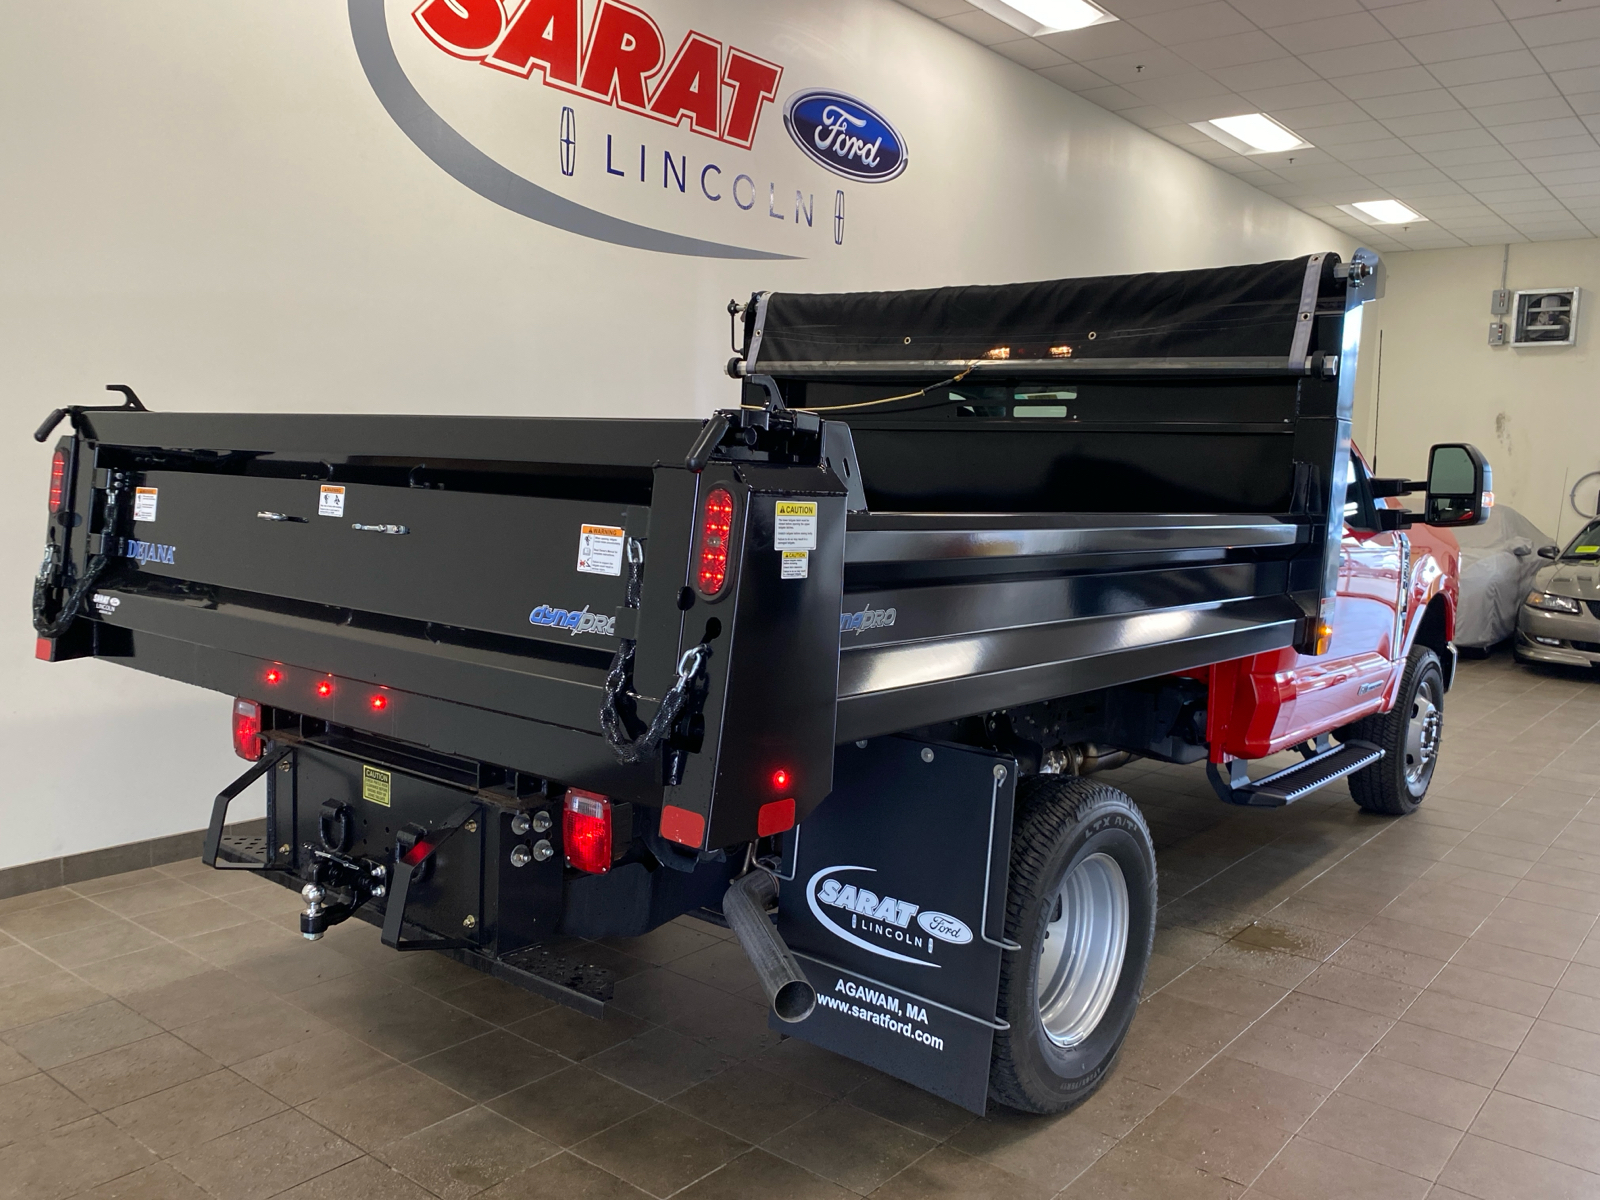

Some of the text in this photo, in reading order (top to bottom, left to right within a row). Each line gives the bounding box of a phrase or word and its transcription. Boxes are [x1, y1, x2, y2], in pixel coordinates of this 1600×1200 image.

[814, 105, 883, 168] Ford
[606, 133, 814, 228] LINCOLN
[786, 505, 814, 514] CAUTION
[593, 528, 617, 536] WARNING
[127, 539, 175, 565] DEJANA
[366, 769, 388, 782] CAUTION
[817, 879, 919, 929] SARAT
[861, 919, 922, 948] LINCOLN
[929, 916, 961, 938] Ford
[835, 979, 929, 1025] AGAWAM, MA
[817, 993, 944, 1051] www.saratford.com
